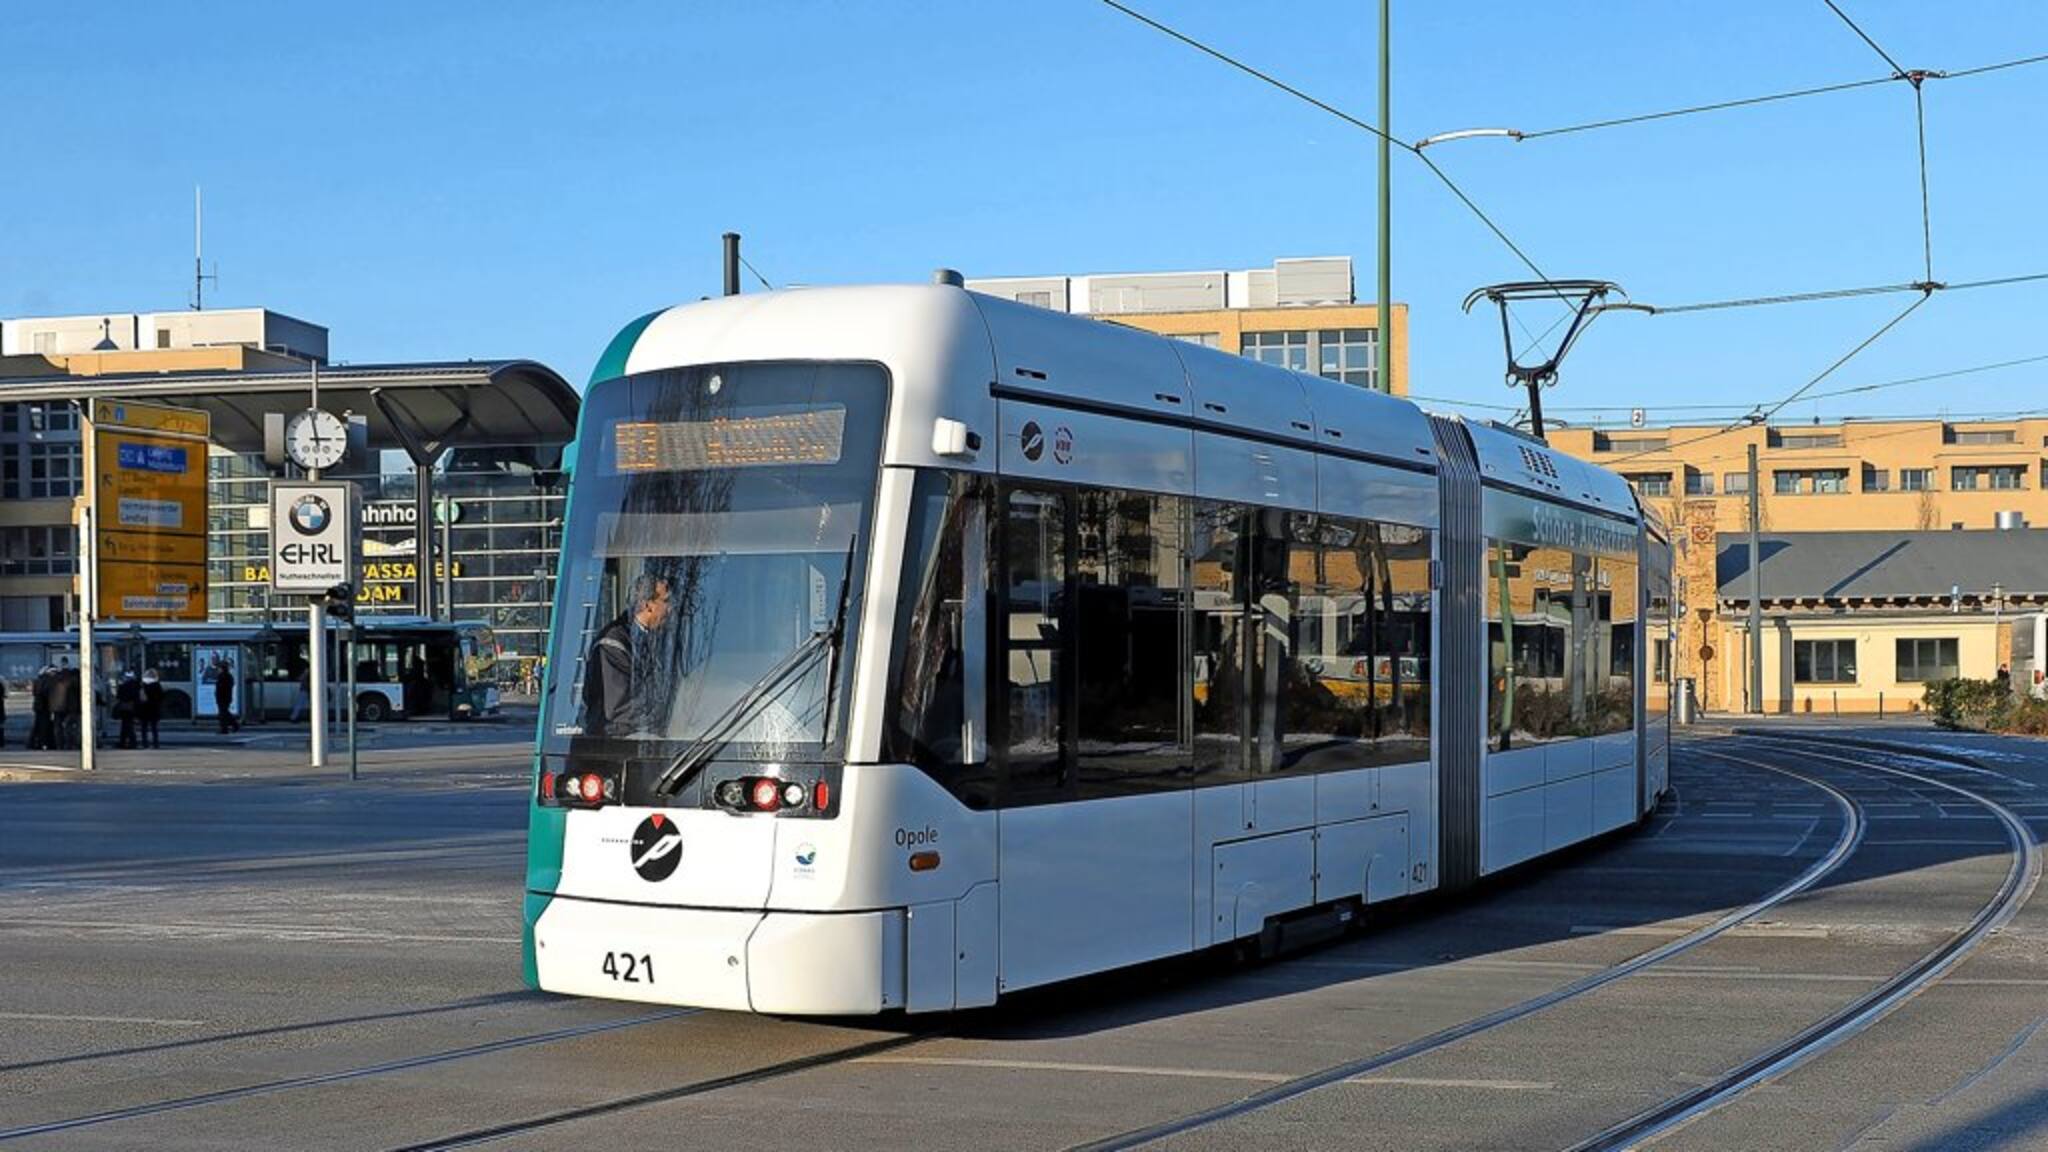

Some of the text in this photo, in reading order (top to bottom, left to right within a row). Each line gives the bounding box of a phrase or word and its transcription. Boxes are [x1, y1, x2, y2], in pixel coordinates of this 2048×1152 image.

[293, 494, 328, 511] BMW
[279, 543, 342, 564] EHRL
[895, 825, 939, 850] Opole
[602, 951, 655, 984] 421
